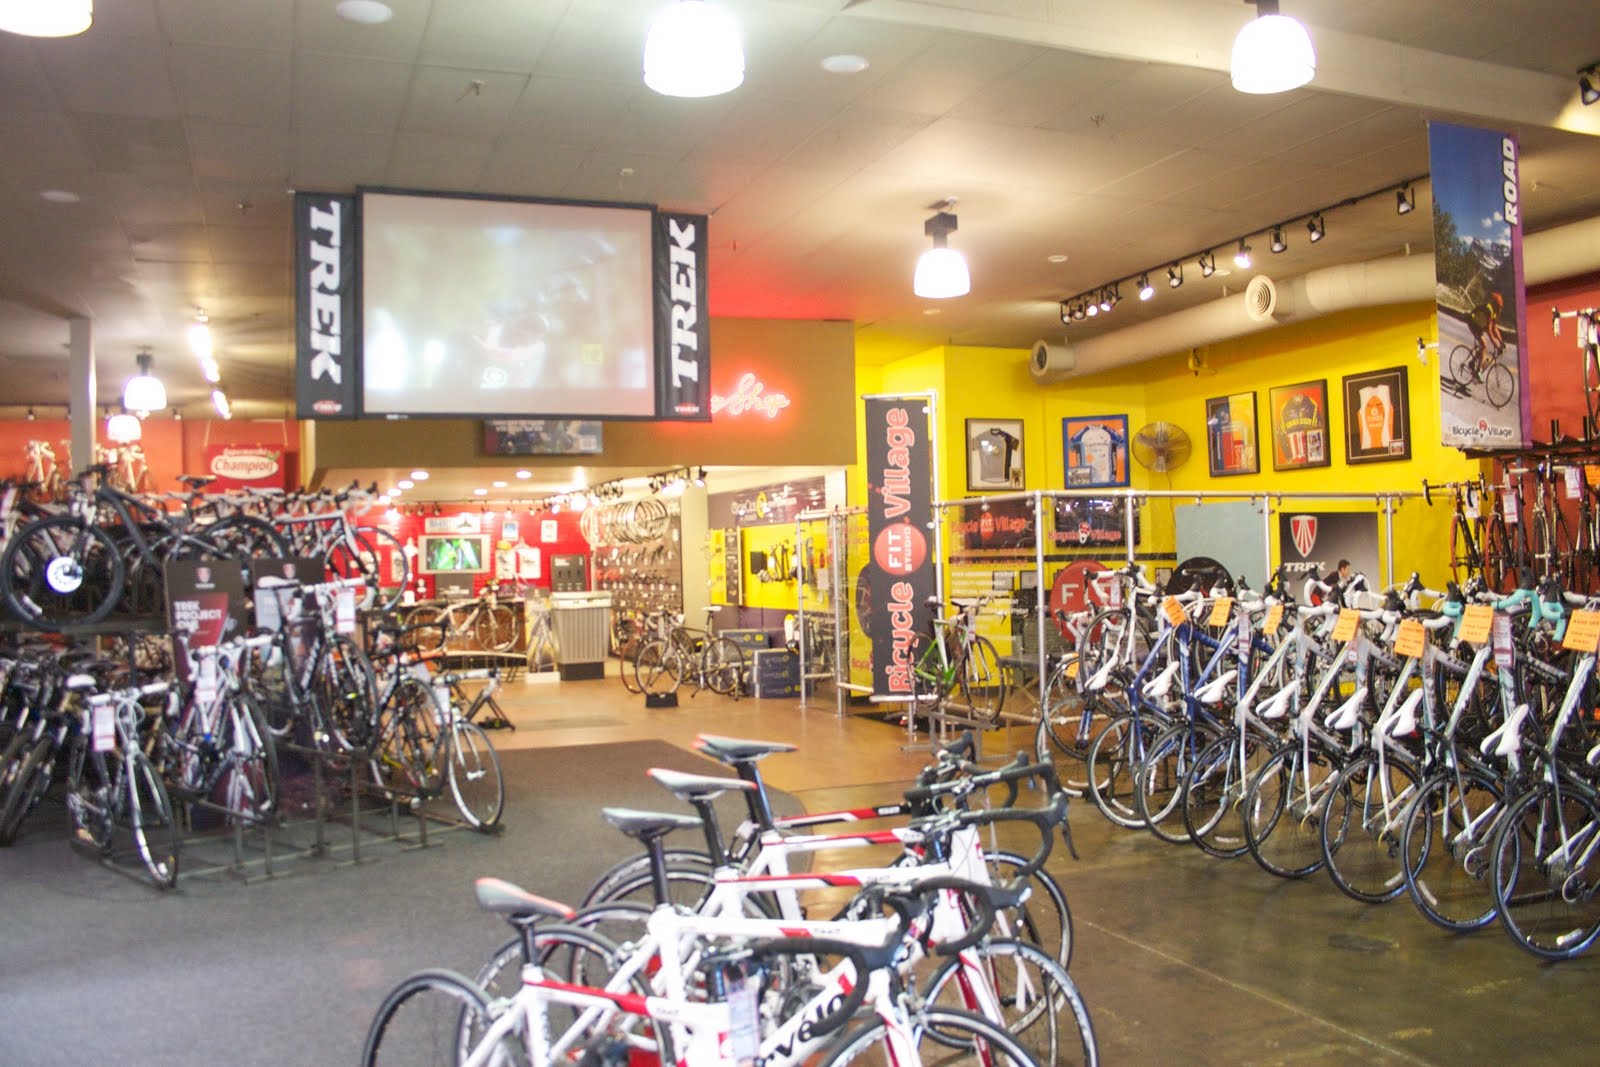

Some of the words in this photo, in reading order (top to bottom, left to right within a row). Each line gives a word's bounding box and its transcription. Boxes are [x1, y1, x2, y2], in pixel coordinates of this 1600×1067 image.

[1501, 137, 1518, 226] ROAD
[309, 200, 342, 385] TREK
[668, 217, 699, 389] TREK
[727, 372, 791, 418] Shop
[1452, 426, 1480, 437] Bicycle
[1488, 427, 1513, 437] Village
[215, 458, 274, 474] Champion
[881, 407, 915, 519] Village
[887, 529, 902, 570] FIT
[903, 526, 913, 572] STUDIO
[1090, 529, 1122, 542] Village
[175, 609, 222, 621] PROJECT
[885, 581, 919, 693] Bicycle
